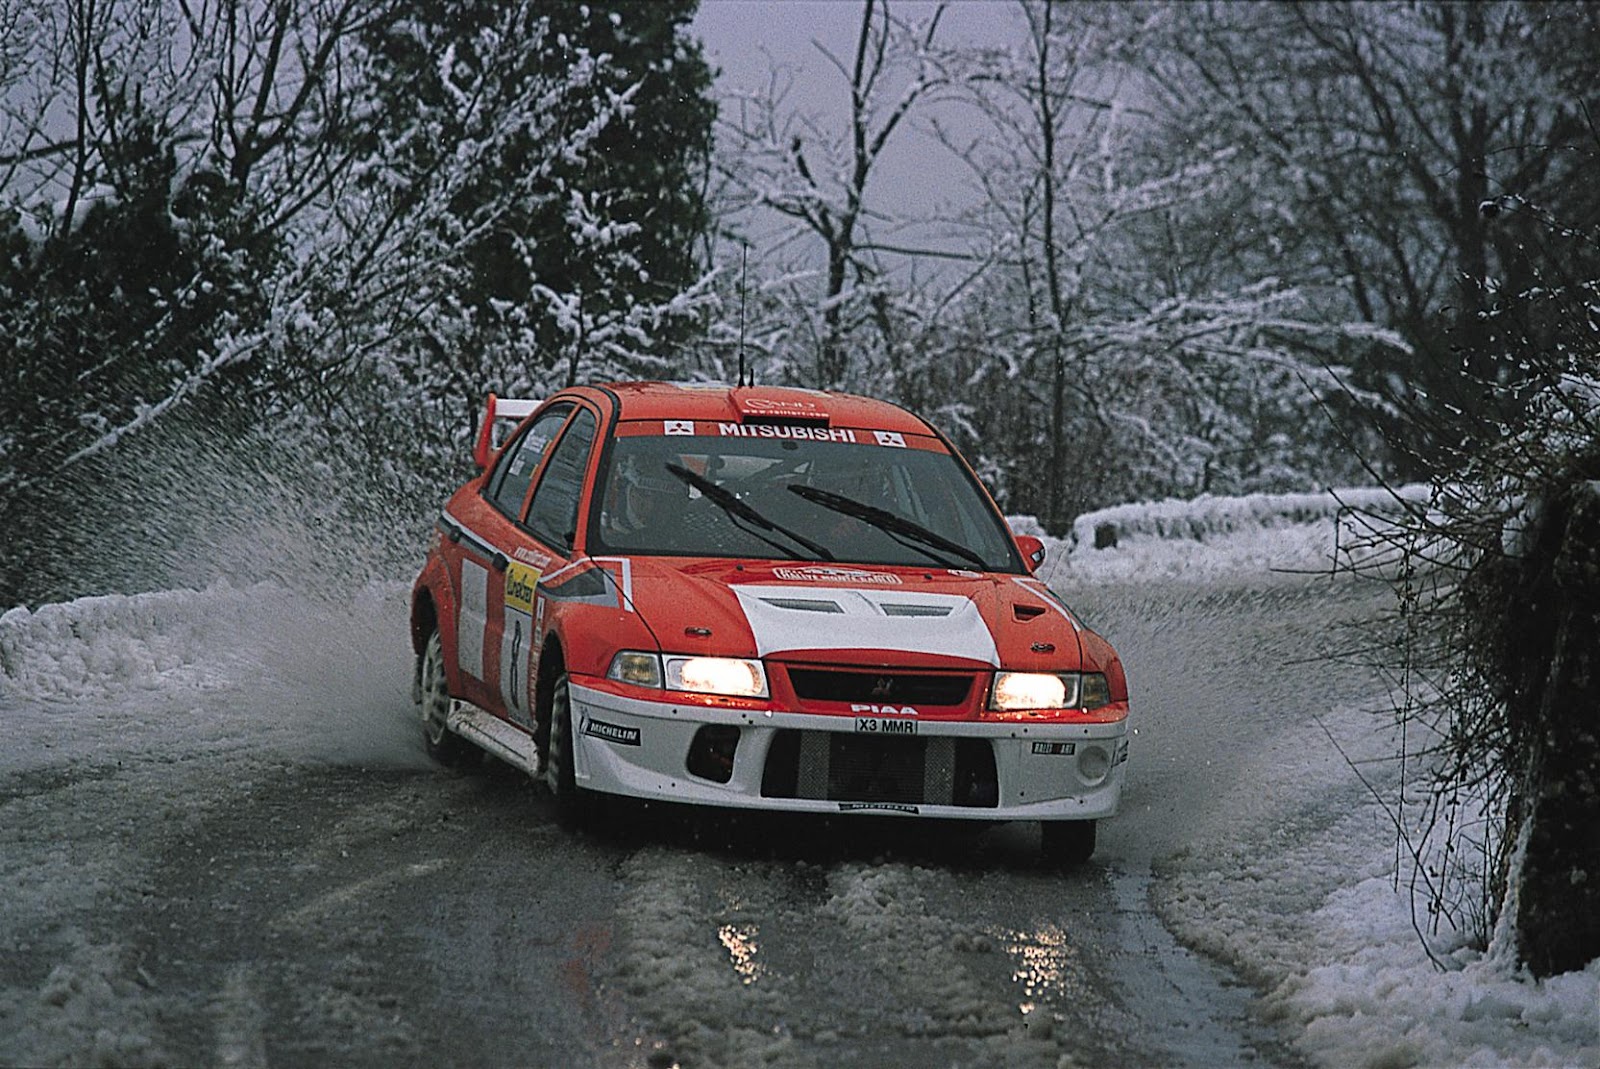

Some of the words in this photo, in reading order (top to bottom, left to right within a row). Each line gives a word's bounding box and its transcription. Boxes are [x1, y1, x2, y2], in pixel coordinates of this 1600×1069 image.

[718, 423, 856, 443] MITSUBISHI
[851, 704, 918, 716] PIAA
[590, 722, 638, 741] MICHELIN
[859, 719, 877, 731] X3
[881, 720, 914, 733] MMR
